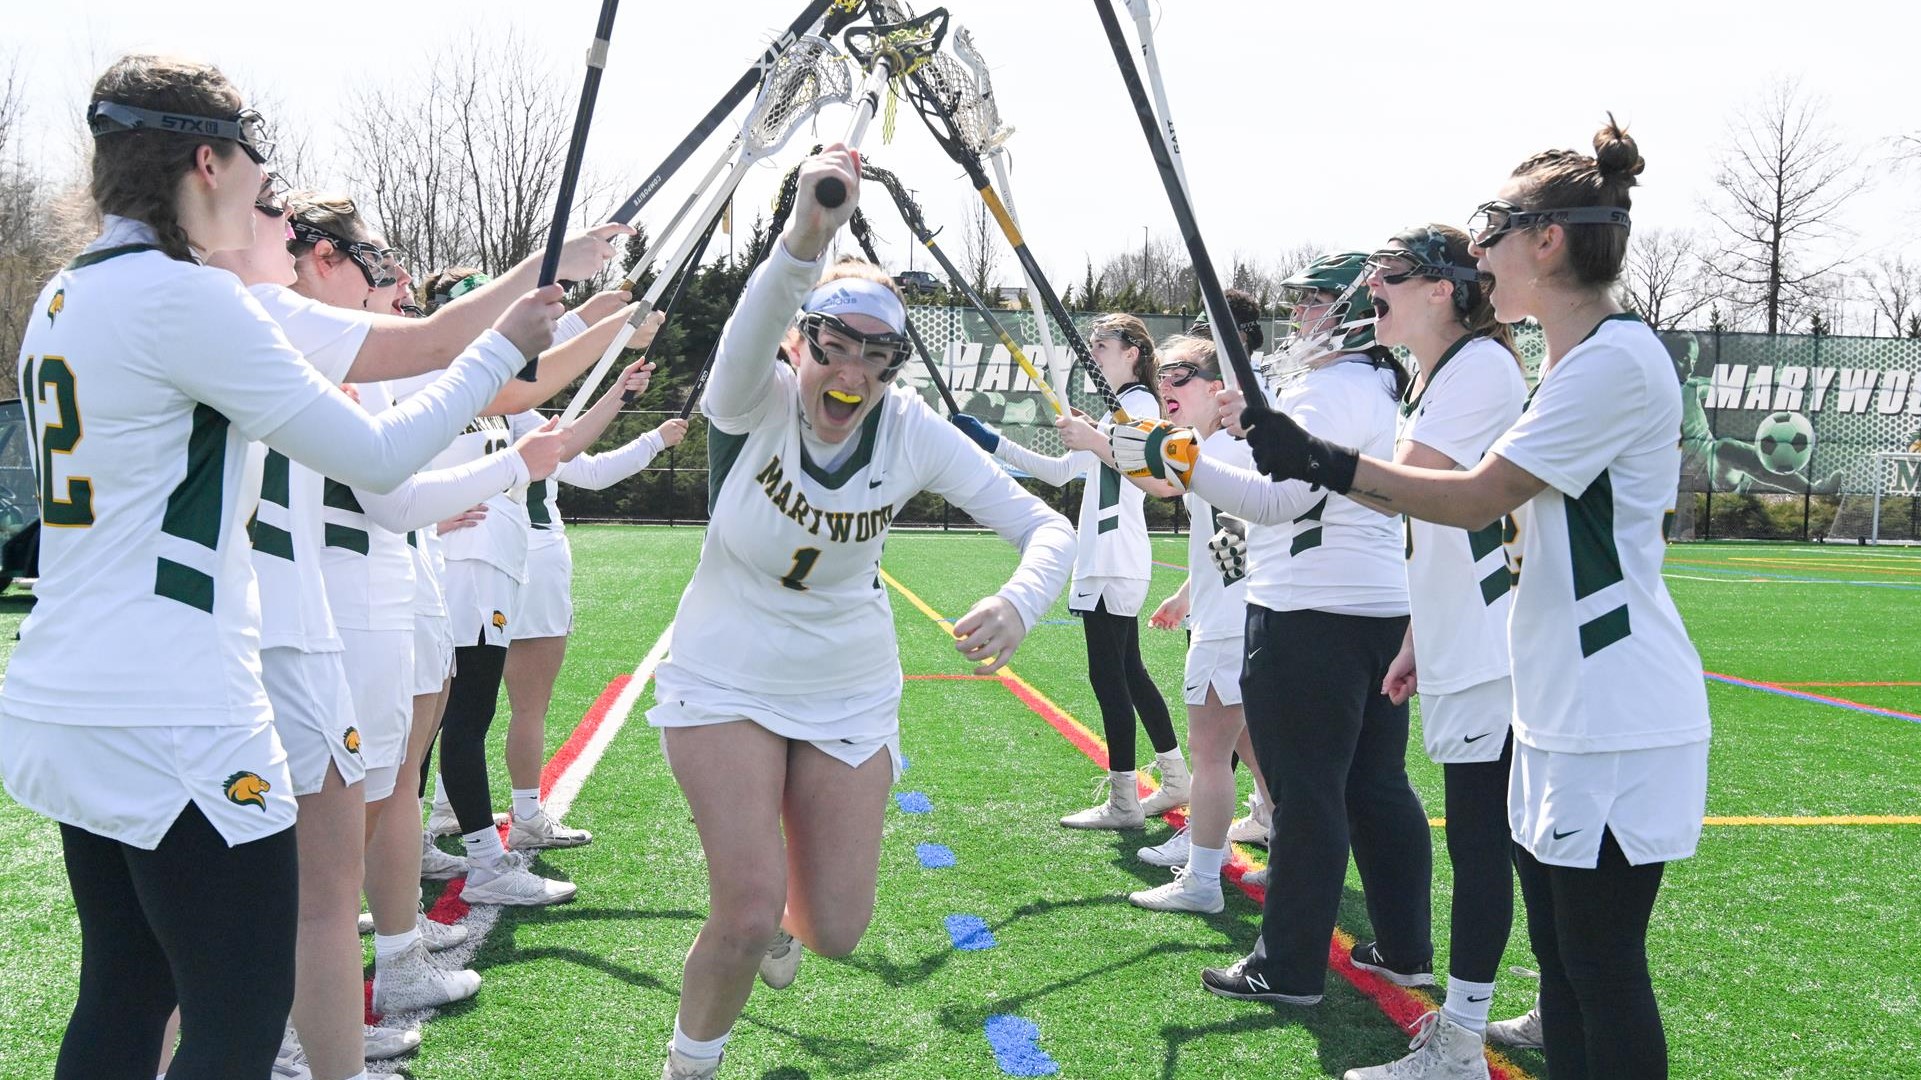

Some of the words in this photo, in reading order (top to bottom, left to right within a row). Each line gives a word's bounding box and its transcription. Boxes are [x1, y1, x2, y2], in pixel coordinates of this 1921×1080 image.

[162, 115, 203, 133] STX
[633, 174, 662, 207] COMPOSITE
[23, 355, 96, 528] 12
[780, 547, 823, 592] 1
